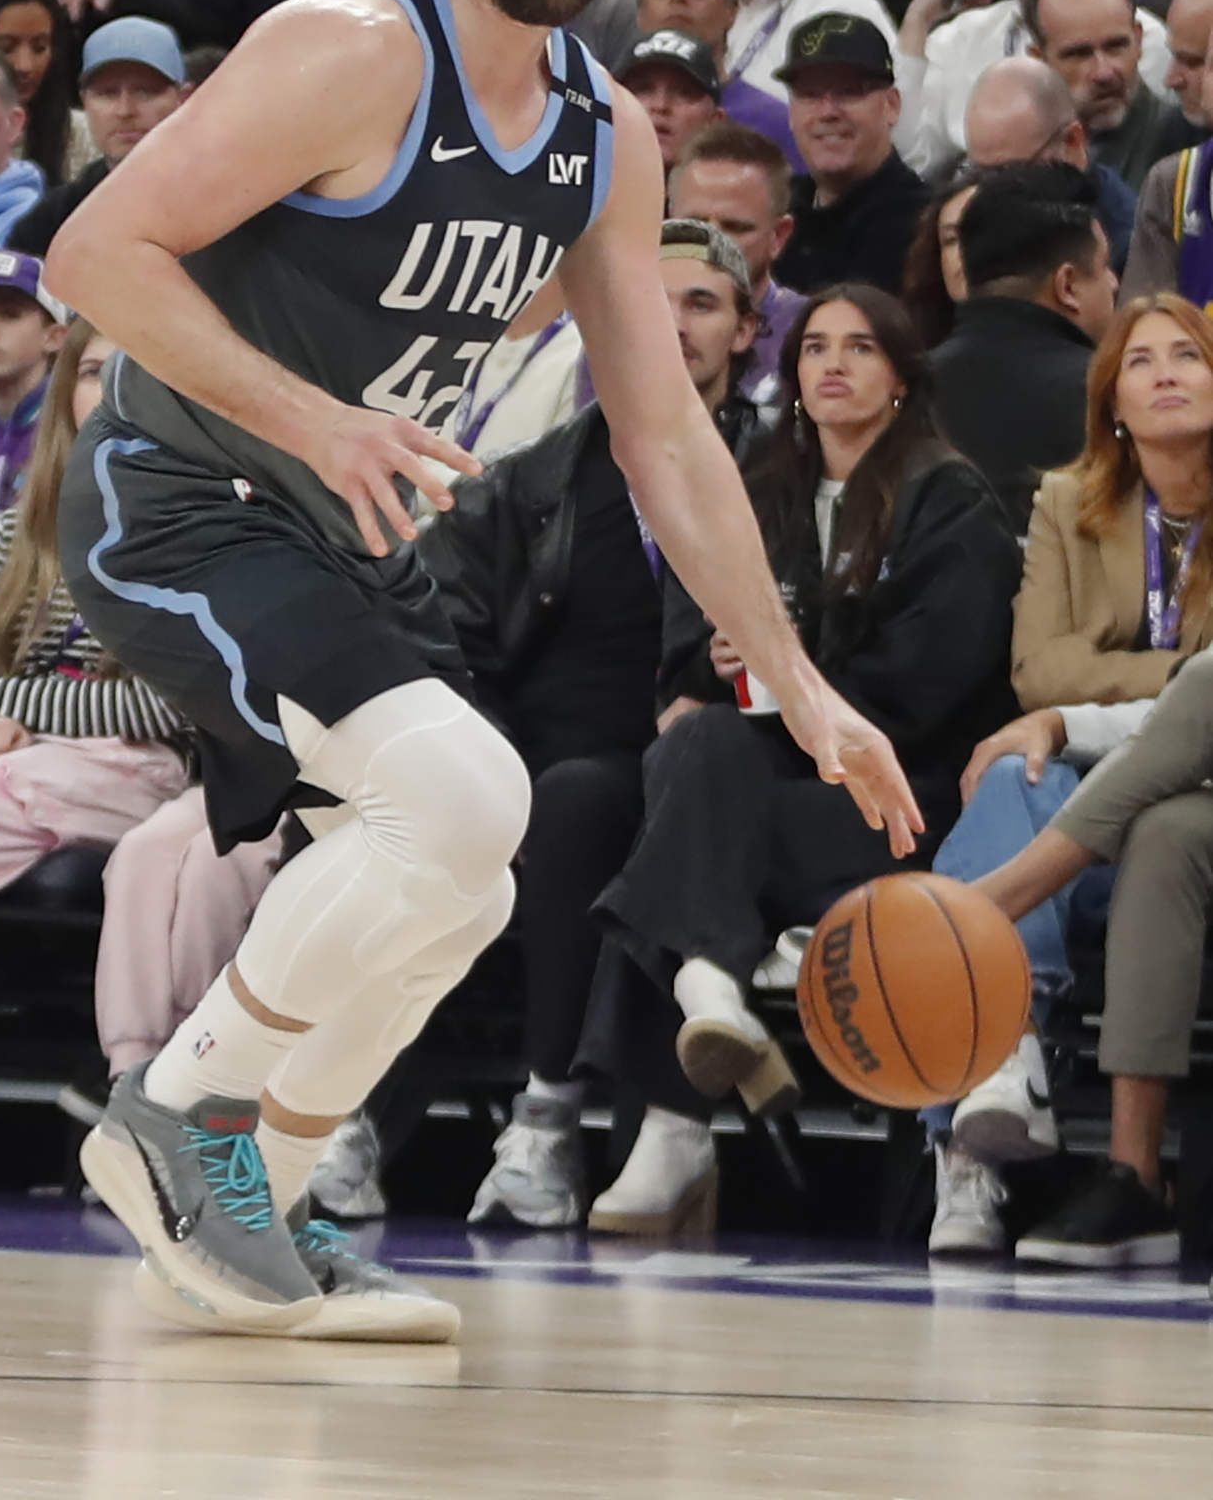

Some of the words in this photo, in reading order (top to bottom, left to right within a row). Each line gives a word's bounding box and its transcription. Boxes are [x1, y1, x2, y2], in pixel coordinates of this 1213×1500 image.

[548, 152, 589, 186] LVT
[378, 219, 565, 322] UTAH
[821, 918, 883, 1075] Wilson
